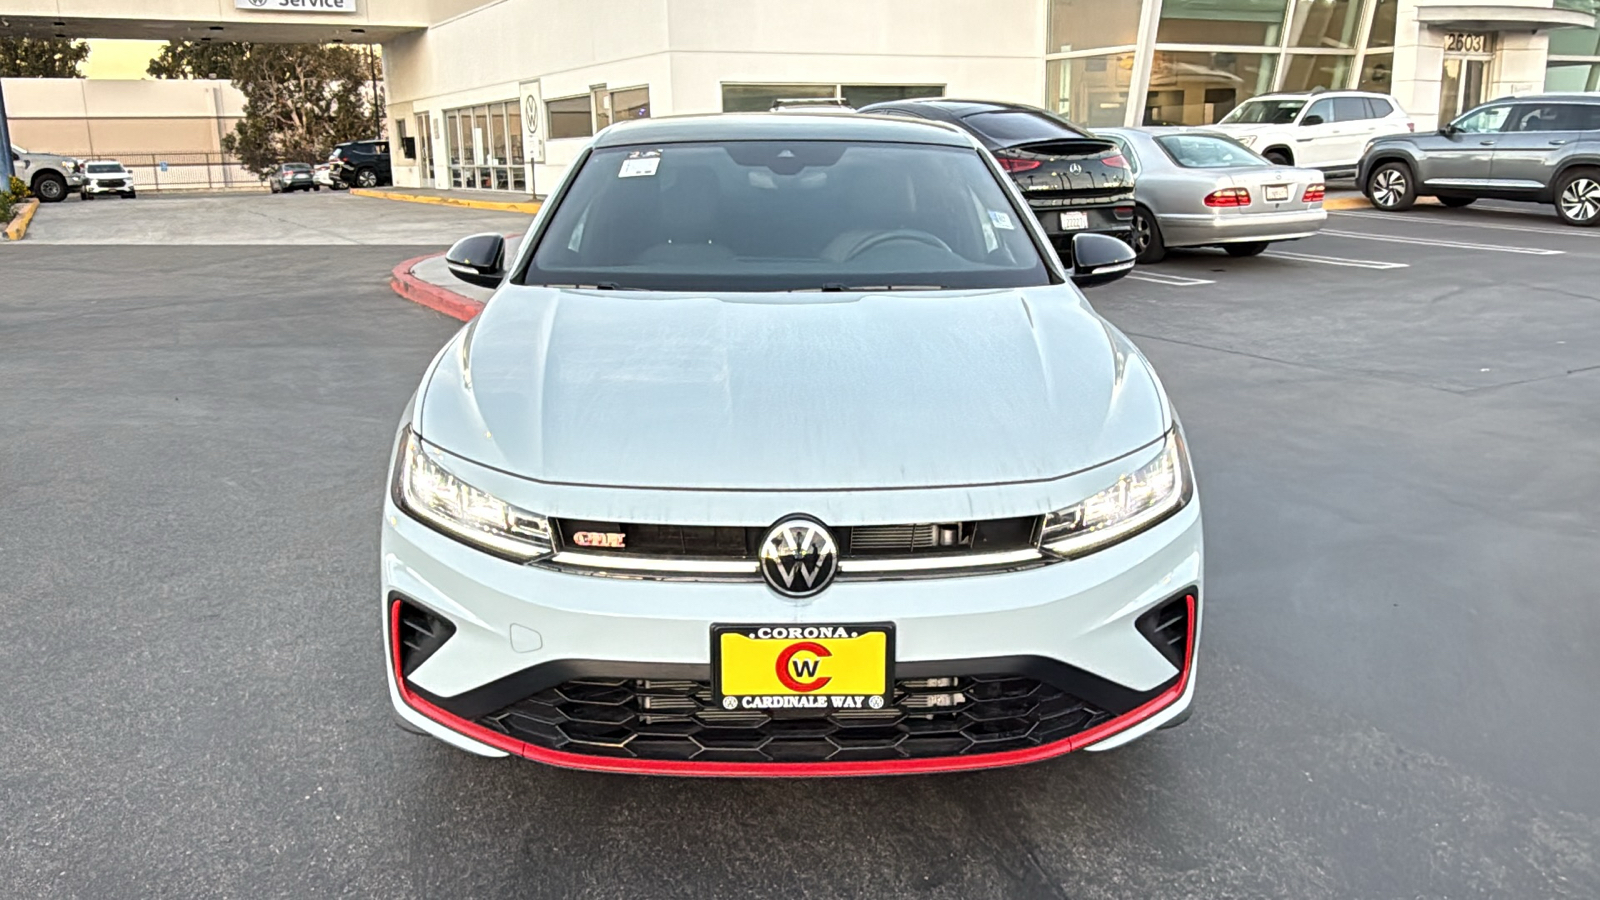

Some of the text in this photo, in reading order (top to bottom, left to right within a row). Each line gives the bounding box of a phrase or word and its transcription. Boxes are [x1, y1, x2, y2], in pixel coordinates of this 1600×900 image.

[758, 627, 848, 639] CORONA
[742, 696, 827, 708] CARDINALE
[830, 695, 865, 707] WAY
